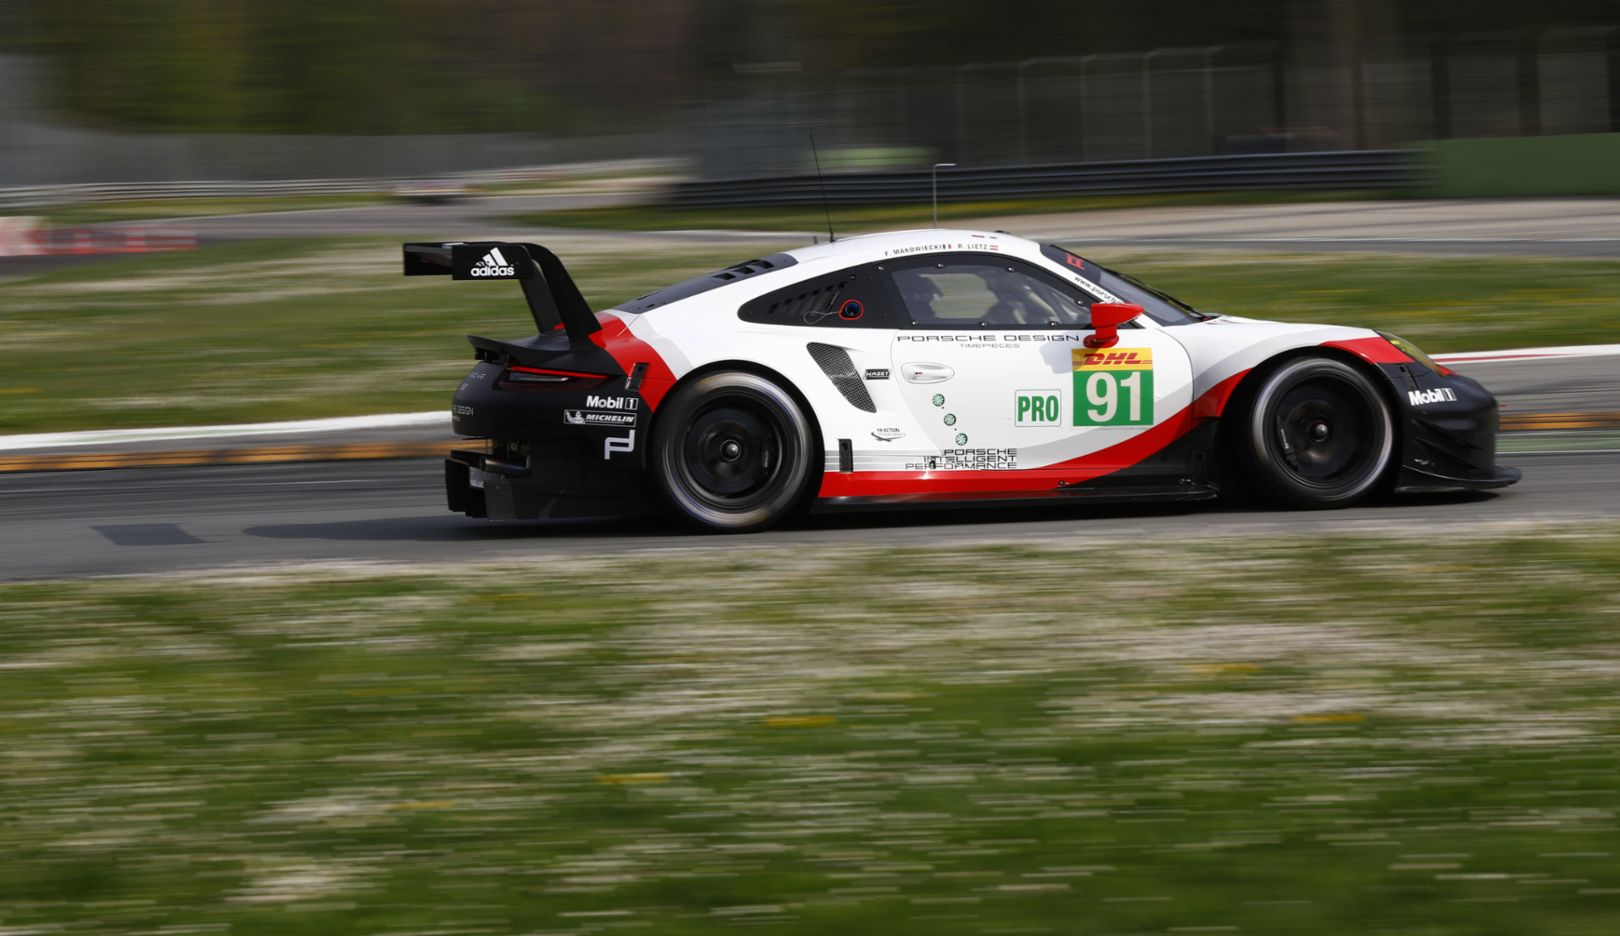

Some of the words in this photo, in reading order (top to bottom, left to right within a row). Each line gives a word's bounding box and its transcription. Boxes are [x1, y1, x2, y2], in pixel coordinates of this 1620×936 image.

[470, 265, 514, 276] adidas
[1082, 352, 1145, 366] DHL
[586, 394, 624, 409] Mobil
[1086, 372, 1142, 423] 91
[1408, 388, 1445, 406] Mobil
[1017, 395, 1060, 422] PRO
[586, 414, 634, 422] MICHELIN
